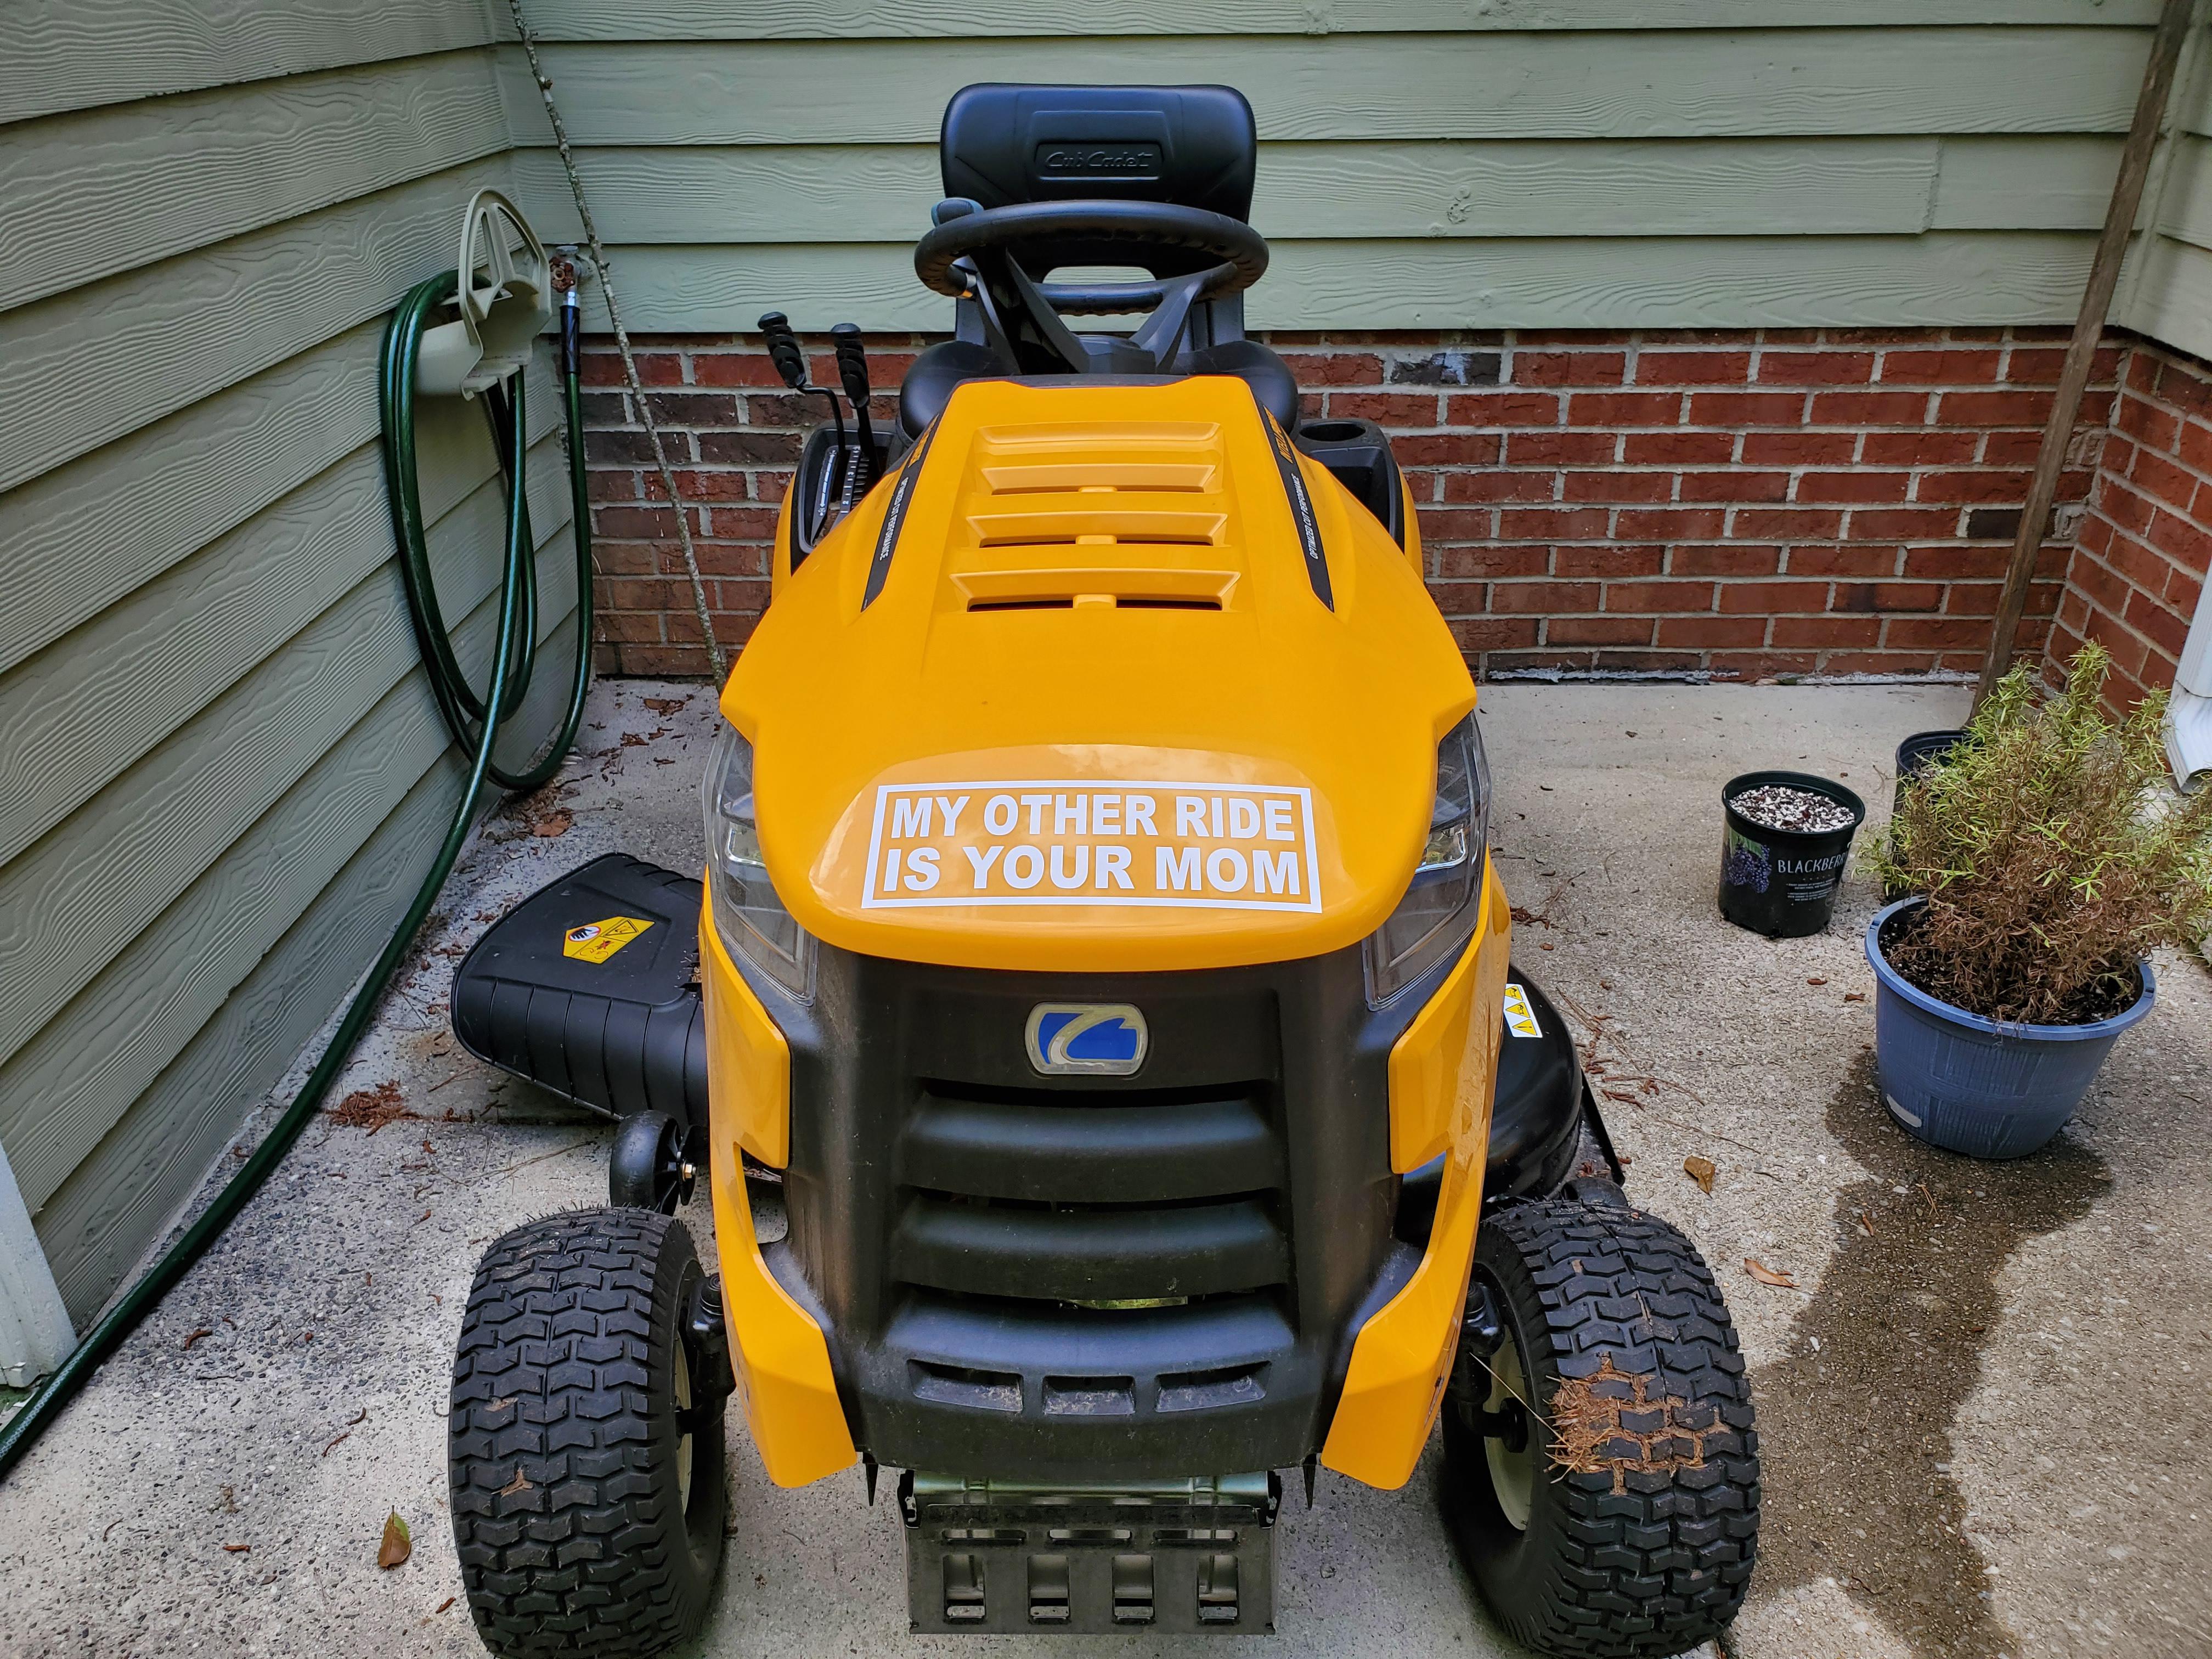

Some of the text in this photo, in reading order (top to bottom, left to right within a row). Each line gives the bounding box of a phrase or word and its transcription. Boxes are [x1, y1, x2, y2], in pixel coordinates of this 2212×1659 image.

[1045, 151, 1154, 167] Cub Cadet
[1291, 473, 1319, 560] OPTIMIZED CUT PERFORMANCE
[891, 794, 1295, 841] MY OTHER RIDE
[883, 845, 1301, 895] IS YOUR MOM
